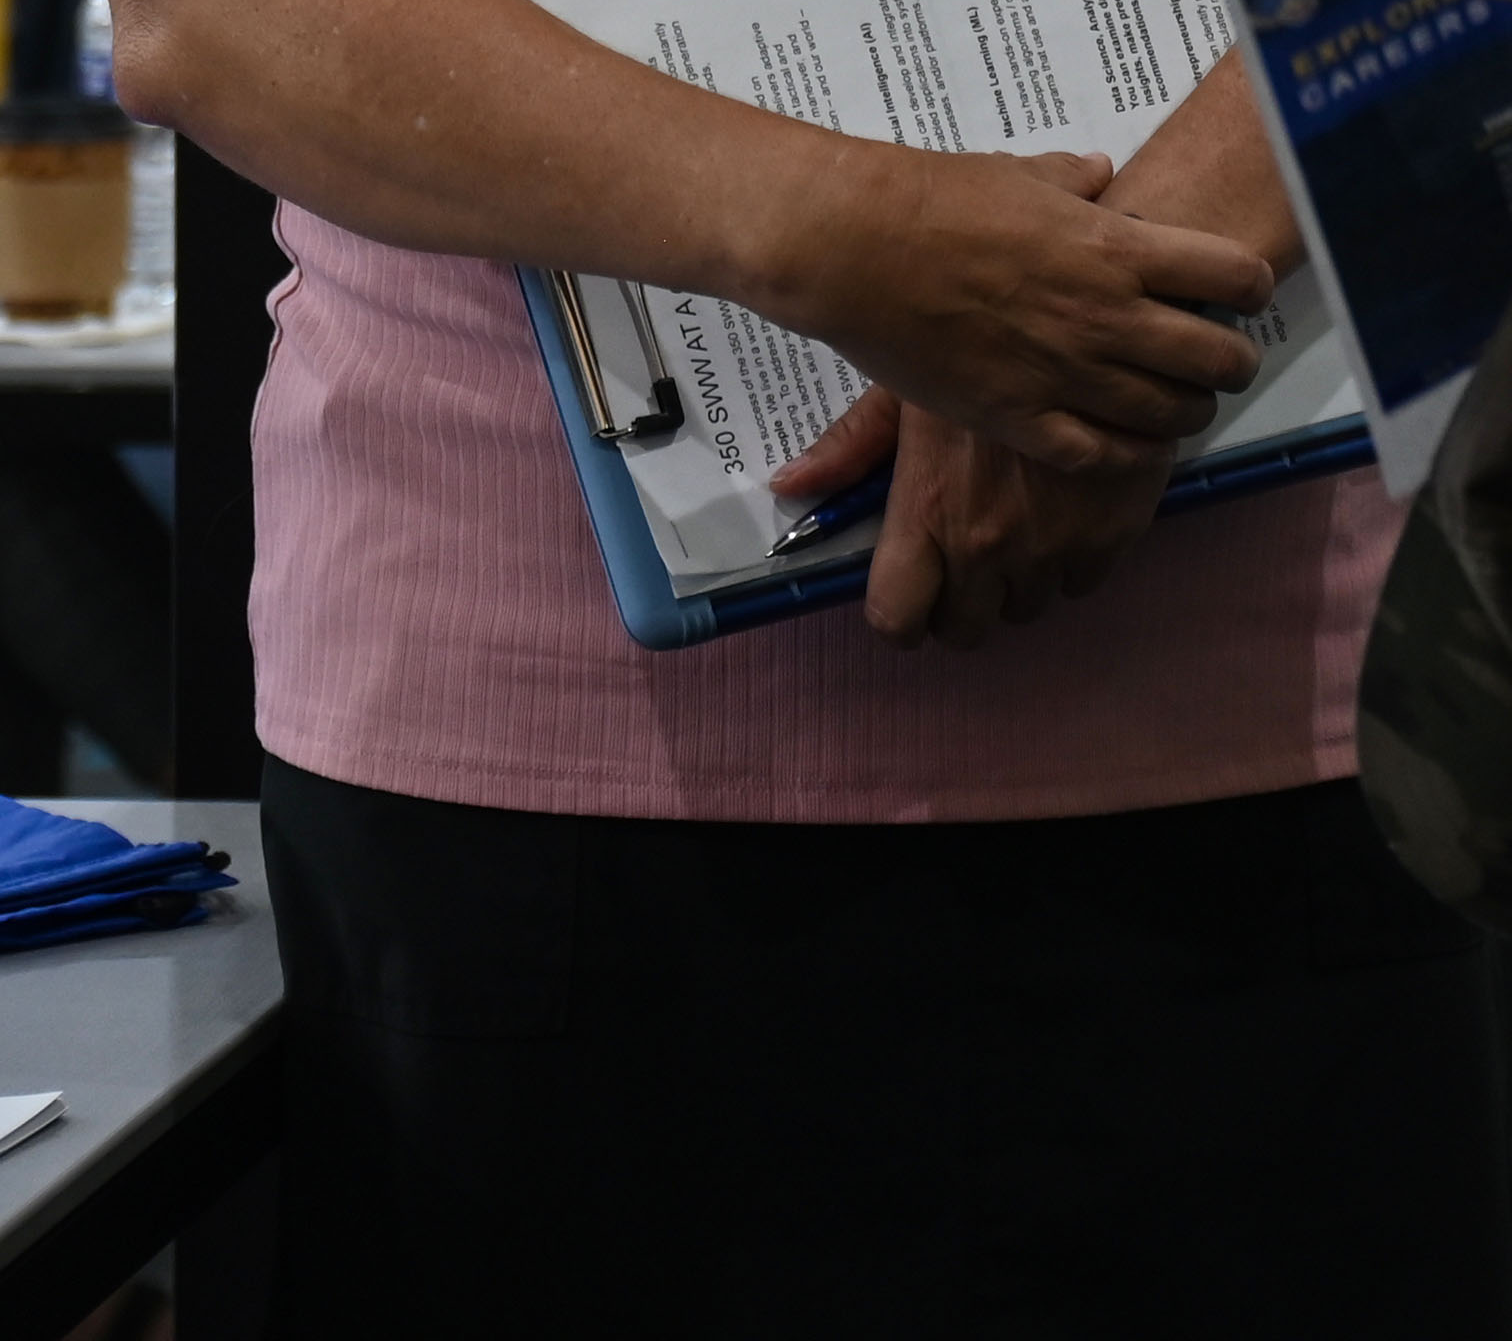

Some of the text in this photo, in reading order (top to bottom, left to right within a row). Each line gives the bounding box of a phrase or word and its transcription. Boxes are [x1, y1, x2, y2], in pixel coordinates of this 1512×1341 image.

[1022, 4, 1037, 26] and
[1196, 4, 1216, 43] identify
[751, 22, 773, 70] adaptive
[787, 33, 802, 55] and
[799, 19, 817, 52] world
[902, 22, 915, 43] into
[1031, 28, 1044, 49] use
[1103, 11, 1125, 60] examine
[1122, 22, 1139, 54] make
[671, 20, 699, 81] generation
[773, 43, 788, 65] and
[810, 54, 824, 73] our
[891, 44, 907, 66] and
[999, 27, 1022, 79] hands-on
[1036, 50, 1052, 72] that
[1096, 34, 1117, 84] Science,
[751, 75, 762, 92] on
[816, 74, 831, 97] and
[859, 22, 906, 146] ficial Intelligence (AI)
[909, 44, 936, 110] applications
[912, 0, 967, 155] processes, and/or platforms.
[966, 6, 1015, 139] Machine Learning (ML)
[1119, 62, 1132, 84] can
[1134, 56, 1155, 107] insights,
[780, 67, 801, 109] tactical
[900, 68, 920, 112] develop
[1016, 80, 1031, 109] have
[1028, 69, 1054, 129] developing
[1045, 73, 1071, 126] programs
[1111, 85, 1126, 113] Data
[1126, 85, 1140, 111] You
[914, 113, 927, 135] can
[1025, 110, 1038, 134] You
[738, 309, 757, 345] world
[759, 318, 772, 333] the
[727, 332, 743, 355] 350
[737, 357, 750, 377] the
[754, 356, 765, 368] in
[765, 335, 786, 382] address
[802, 351, 818, 374] skill
[674, 298, 745, 475] 350 SWW AT A
[741, 379, 754, 391] of
[759, 370, 771, 391] live
[833, 359, 853, 393] SWW
[765, 393, 778, 415] We
[779, 384, 791, 400] To
[748, 392, 770, 441] success
[764, 443, 777, 468] The
